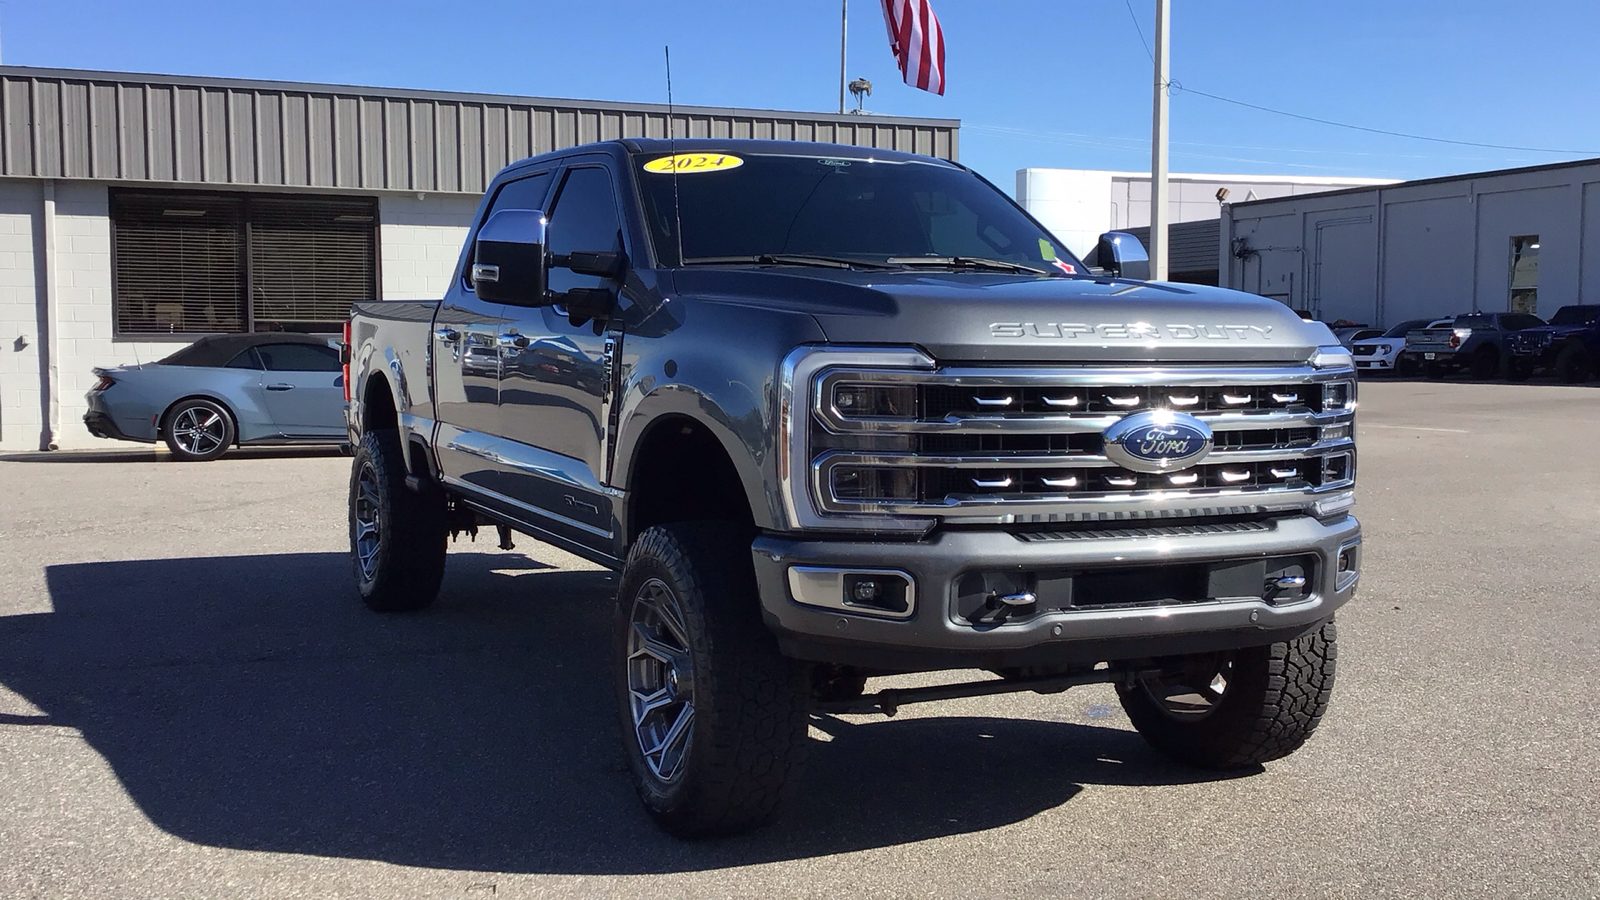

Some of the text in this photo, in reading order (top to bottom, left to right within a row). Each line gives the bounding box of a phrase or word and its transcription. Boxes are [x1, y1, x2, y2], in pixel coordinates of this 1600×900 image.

[660, 156, 726, 171] 2024
[988, 322, 1273, 340] SUPER DUTY
[1140, 428, 1191, 455] Ford
